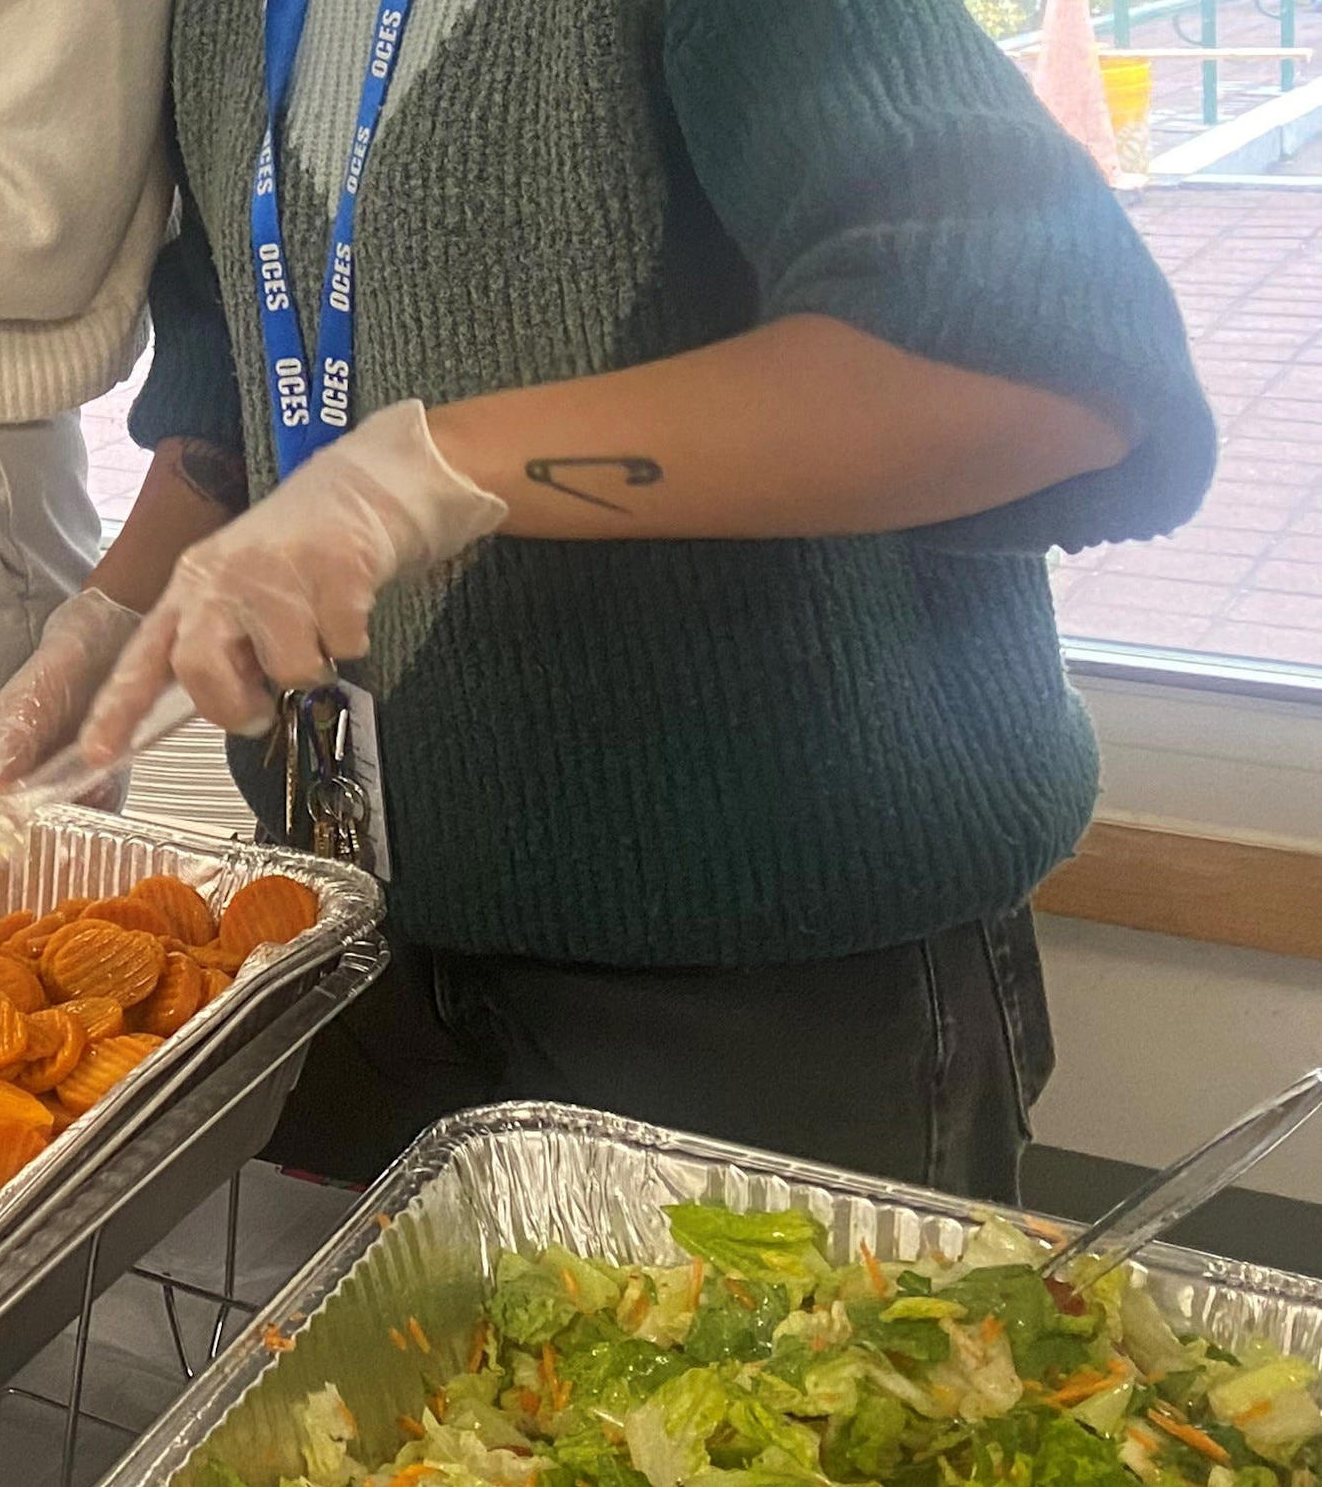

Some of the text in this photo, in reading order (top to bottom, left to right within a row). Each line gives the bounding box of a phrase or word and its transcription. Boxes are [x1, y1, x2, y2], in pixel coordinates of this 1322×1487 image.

[371, 8, 402, 79] OCES
[346, 126, 370, 195] OCES
[259, 243, 289, 312] OCES
[329, 242, 352, 312] OCES
[275, 357, 310, 428] OCES
[320, 357, 350, 428] OCES
